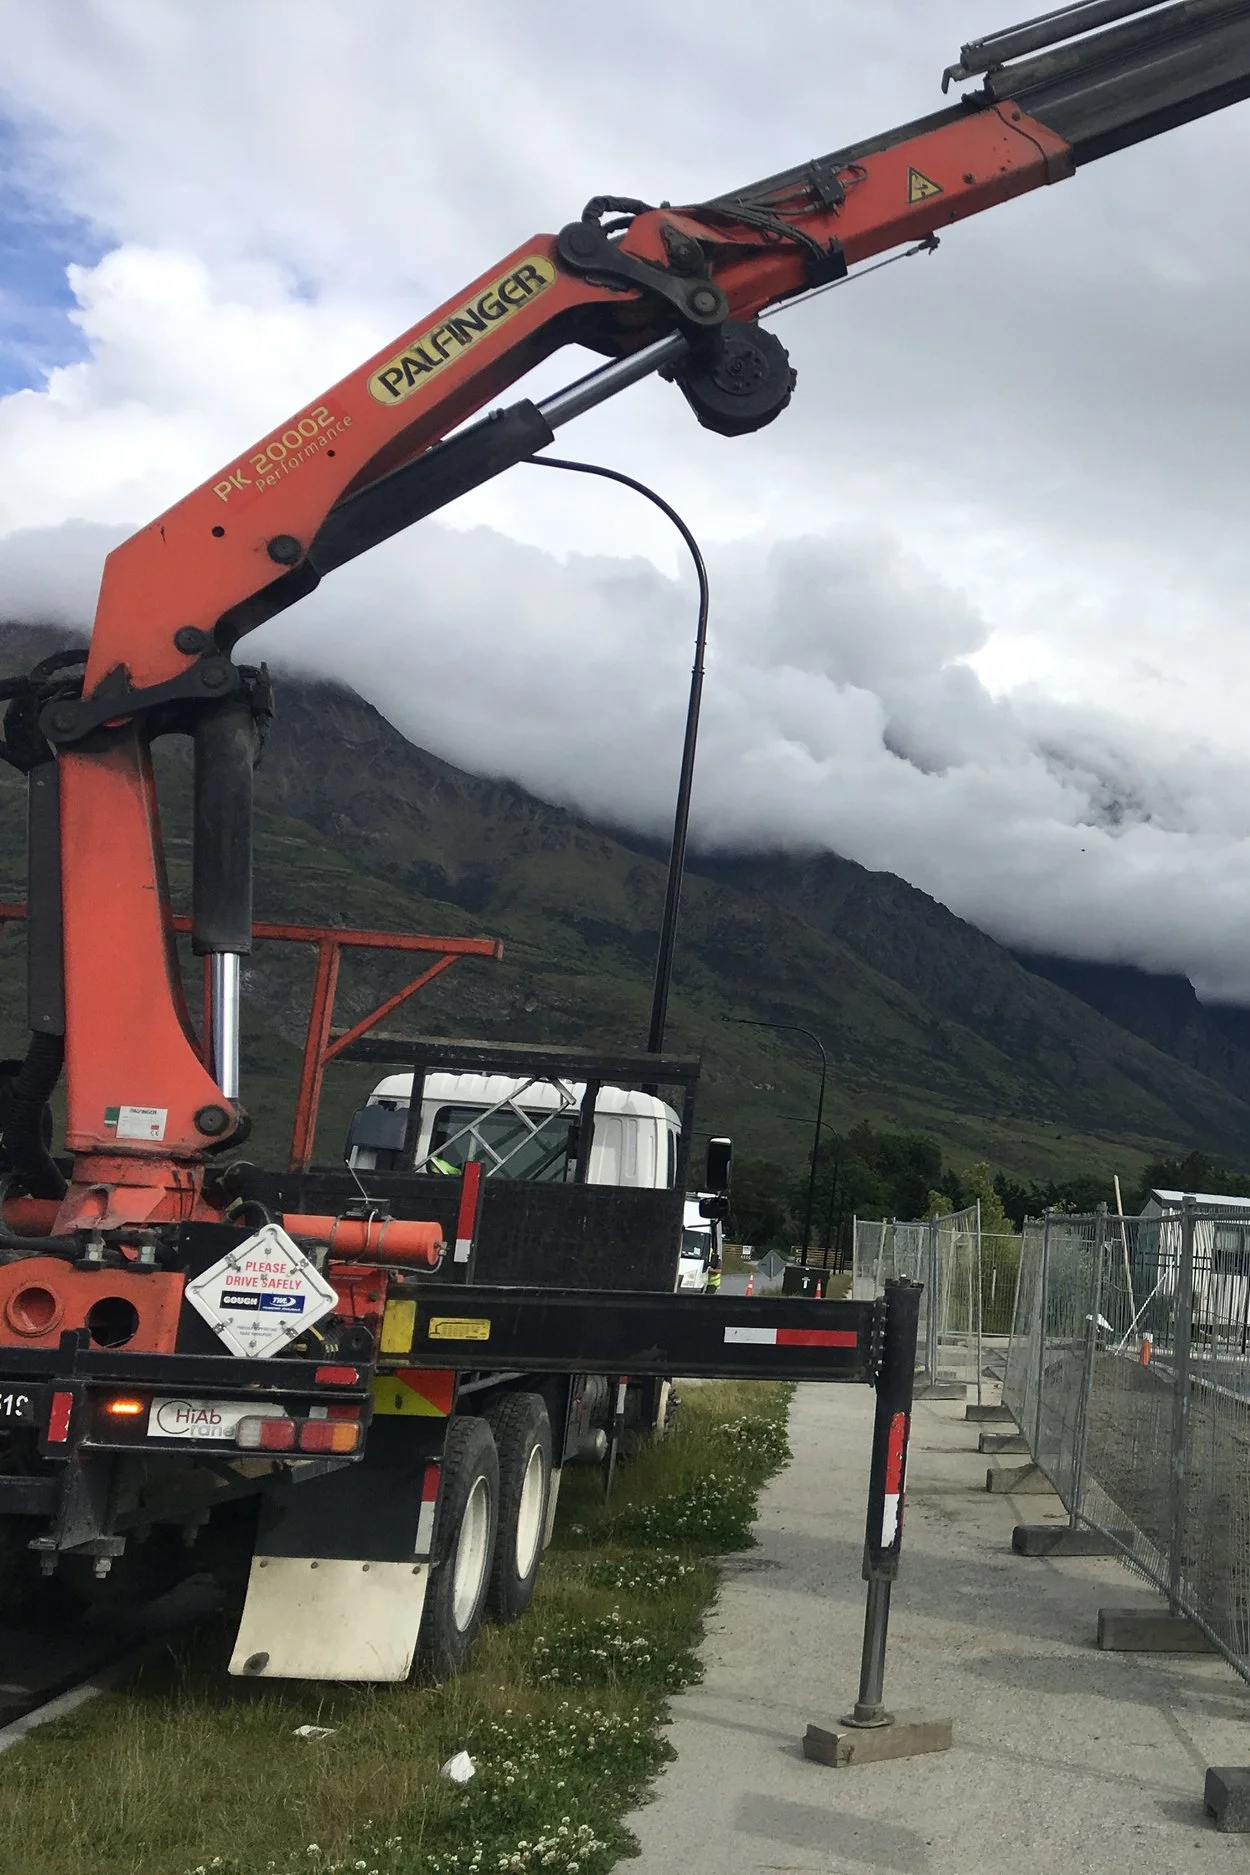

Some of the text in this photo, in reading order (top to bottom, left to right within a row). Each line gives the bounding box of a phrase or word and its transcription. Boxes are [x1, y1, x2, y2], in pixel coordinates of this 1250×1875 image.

[378, 264, 547, 397] PALFINGER
[212, 406, 335, 502] PK 20002
[255, 415, 353, 493] Performance
[245, 1261, 287, 1274] PLEASE
[225, 1275, 302, 1290] DRIVE SAFELY
[223, 1296, 258, 1305] GOUGH
[176, 1408, 222, 1425] HiAb
